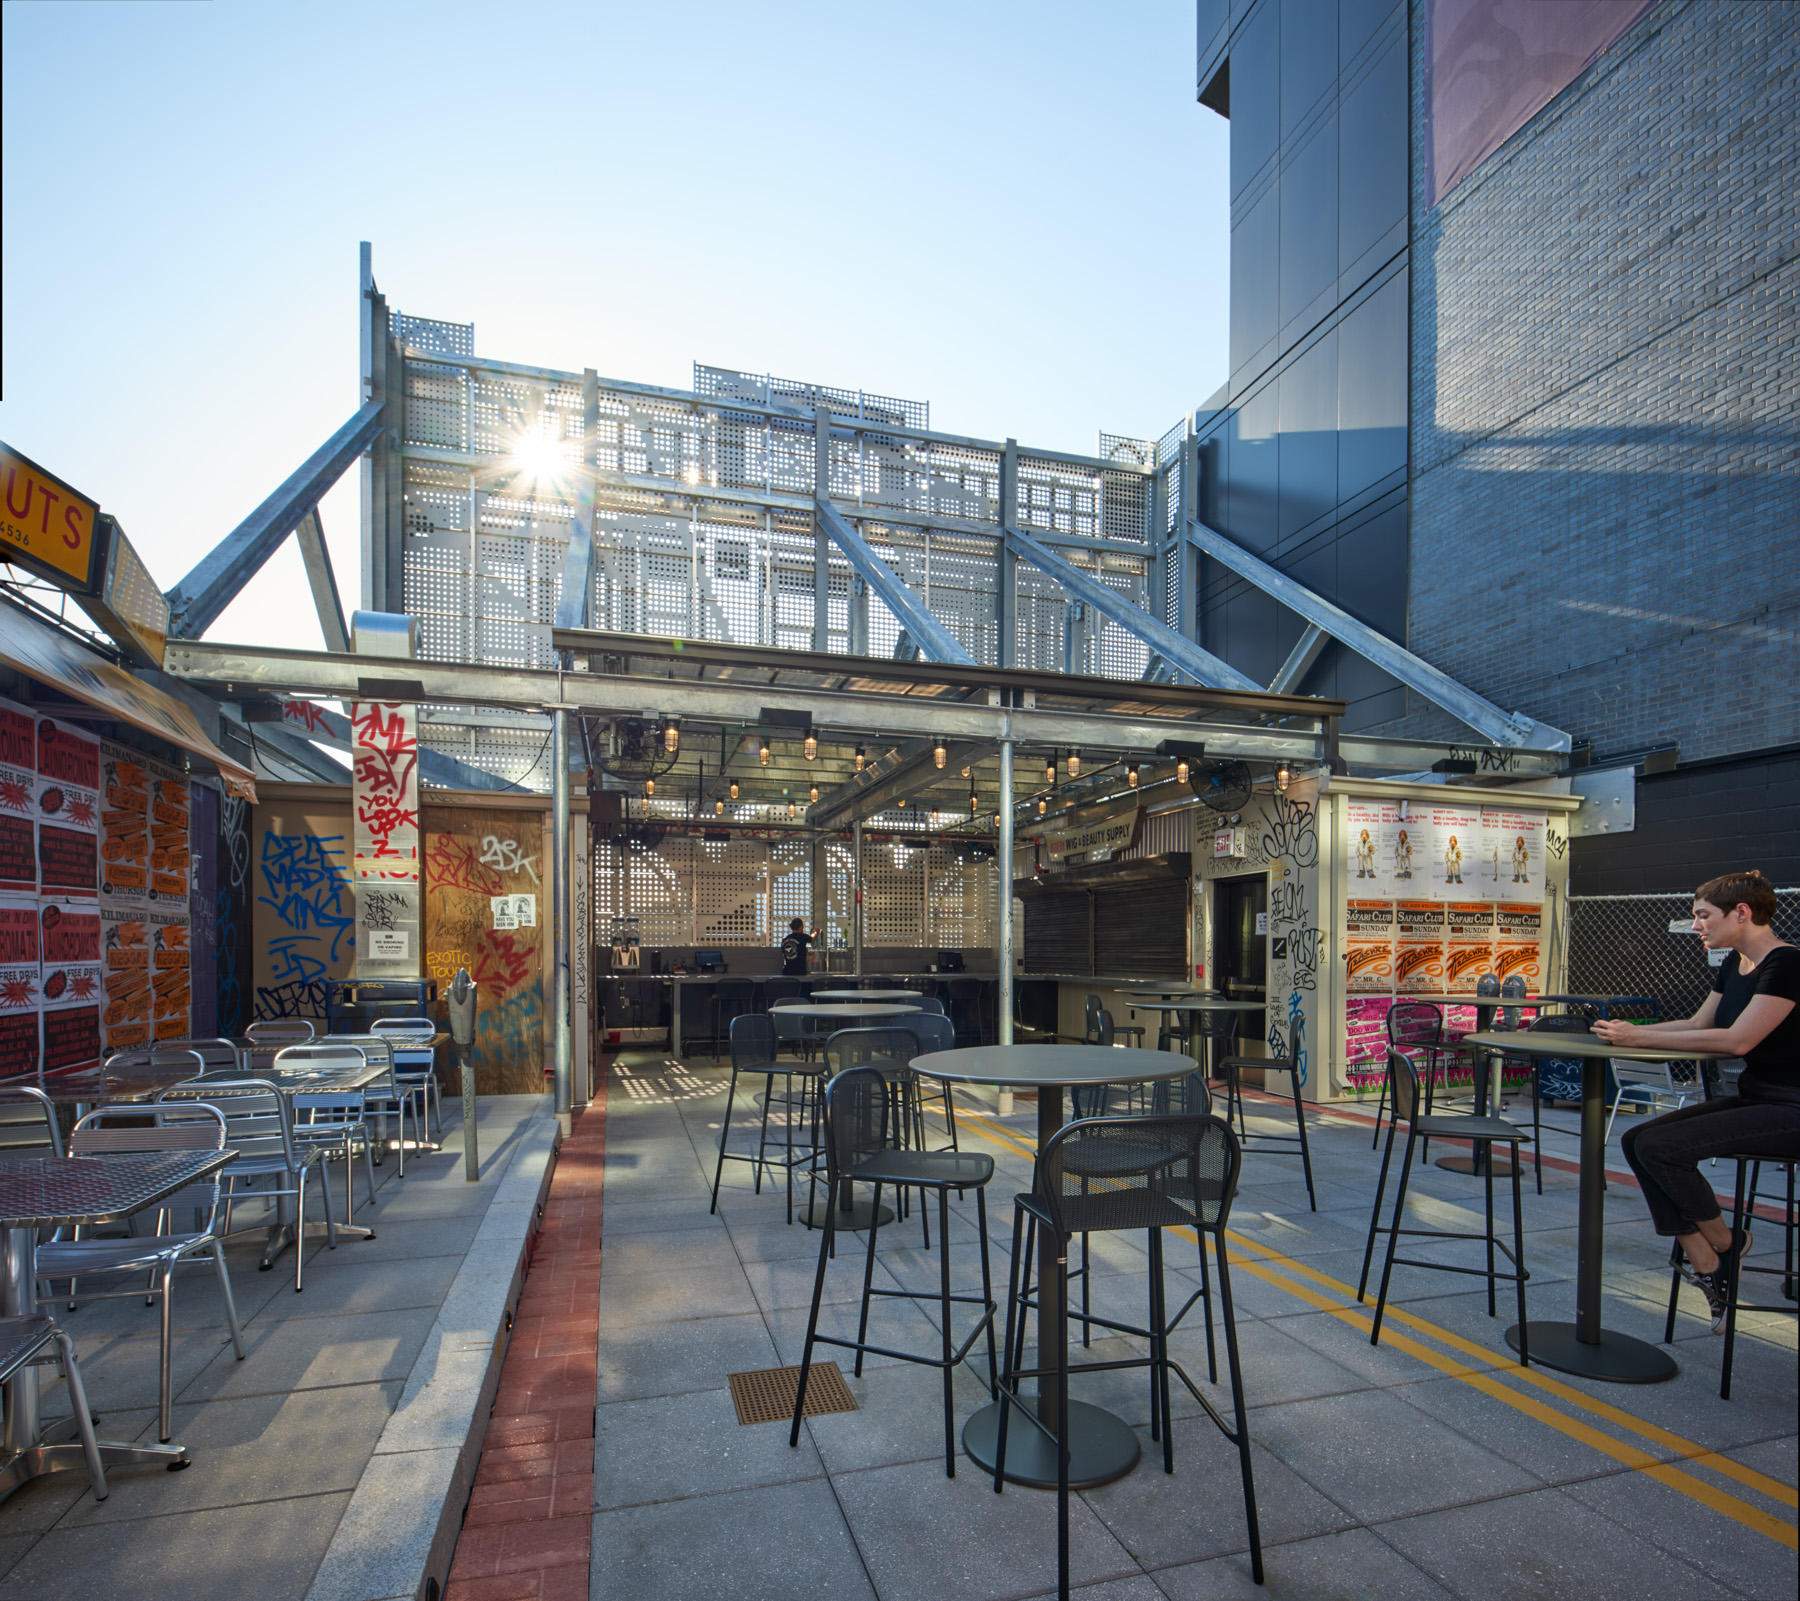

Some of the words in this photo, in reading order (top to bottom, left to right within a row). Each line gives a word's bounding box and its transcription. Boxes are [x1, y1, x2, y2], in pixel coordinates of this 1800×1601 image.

[0, 462, 83, 550] UTS
[0, 729, 33, 769] OMATS
[100, 743, 146, 769] KILIMANJARO
[38, 743, 97, 787] LAUNDROMATS
[0, 771, 14, 784] REE
[149, 762, 189, 787] KILIMANJARO
[65, 788, 81, 801] FREE
[360, 794, 399, 809] YOU
[359, 806, 419, 829] LOOK
[369, 821, 396, 840] UP
[1065, 838, 1078, 852] WIG
[1082, 830, 1106, 848] BEAUTY
[1106, 823, 1131, 842] SUPPLY
[1216, 834, 1230, 852] EXIT
[261, 862, 353, 899] MADE
[113, 886, 148, 897] THURSDAY
[157, 894, 188, 904] THURSDAY
[101, 910, 147, 923] KILIMANJARO
[150, 914, 189, 927] KILIMANJARO
[1346, 910, 1371, 921] SAFARI
[1371, 911, 1392, 922] CLUB
[1398, 911, 1424, 922] SAFARI
[1424, 912, 1443, 923] CLUB
[1448, 913, 1474, 923] SAFARI
[1474, 914, 1493, 924] CLUB
[1498, 915, 1522, 925] SAFARI
[1521, 915, 1540, 926] CLUB
[1512, 927, 1538, 935] SUNDAY
[43, 931, 98, 961] LAUNDROMATS
[110, 951, 147, 967] REGGAE
[156, 952, 187, 966] REGGAE
[426, 950, 472, 965] EXOTIC
[67, 968, 82, 979] FREE
[1364, 1024, 1379, 1032] WOP
